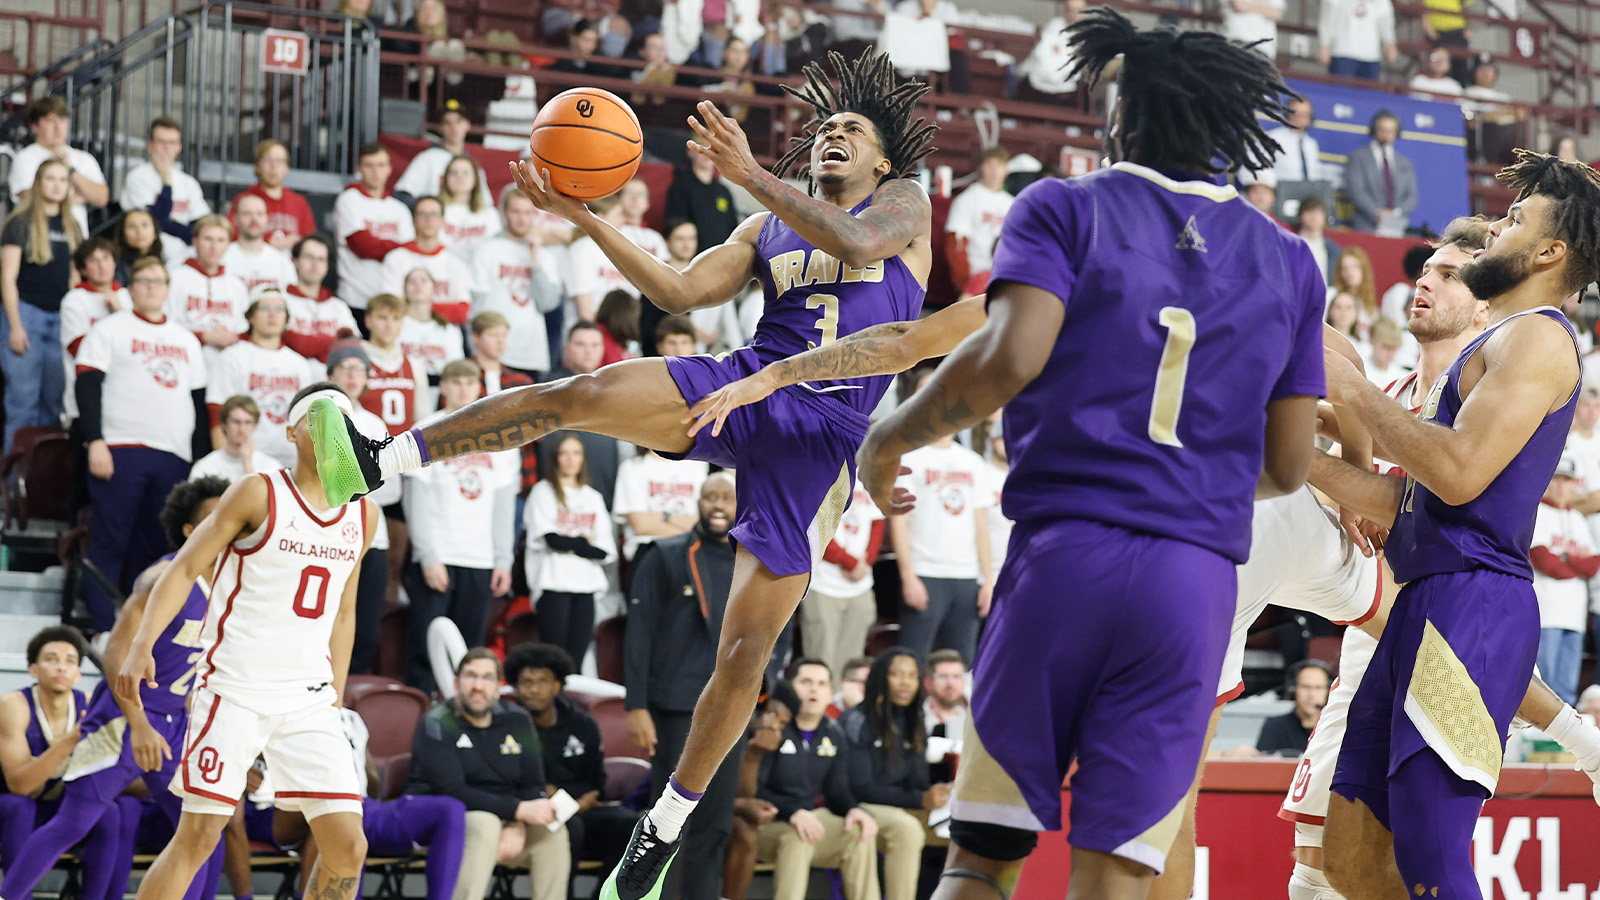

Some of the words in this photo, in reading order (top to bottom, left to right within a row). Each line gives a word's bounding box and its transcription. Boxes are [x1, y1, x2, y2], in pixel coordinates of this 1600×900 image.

[273, 37, 299, 63] 10
[576, 99, 594, 118] OU
[805, 293, 839, 350] 3
[1148, 305, 1197, 448] 1
[381, 389, 406, 426] 0
[279, 539, 356, 562] OKLAHOMA
[292, 564, 331, 619] 0
[198, 746, 224, 784] OU
[1292, 758, 1312, 803] OU
[1472, 816, 1600, 900] KL
